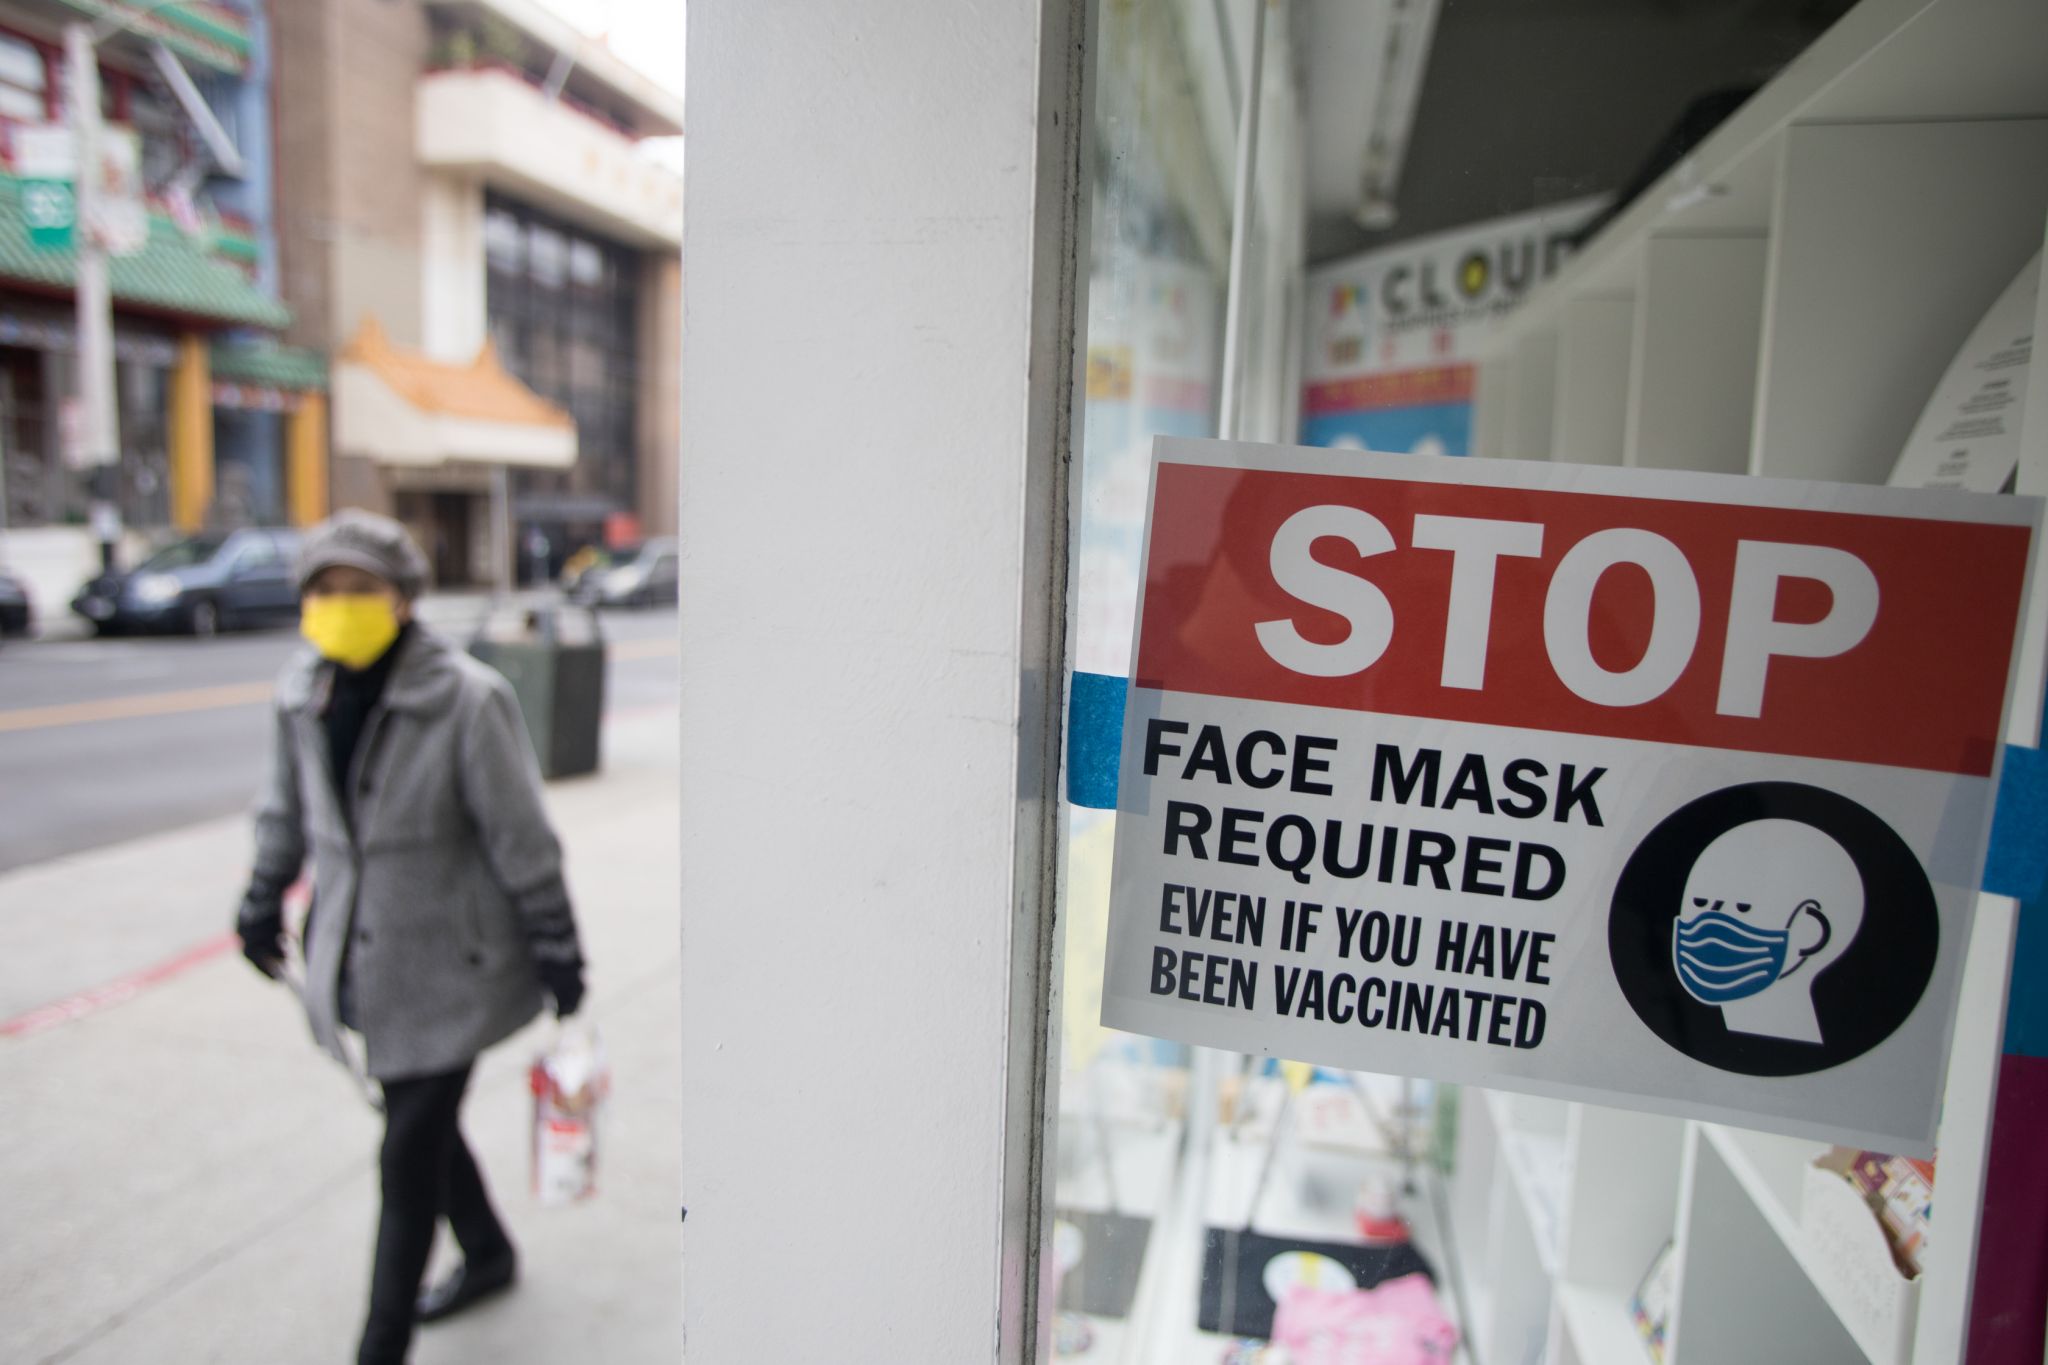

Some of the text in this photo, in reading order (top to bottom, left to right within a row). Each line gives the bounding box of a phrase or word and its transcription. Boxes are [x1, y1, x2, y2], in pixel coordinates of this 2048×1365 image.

[1254, 504, 1880, 719] STOP
[1143, 718, 1609, 828] FACE MASK
[1163, 800, 1567, 901] REQUIRED
[1159, 883, 1556, 986] EVEN IF YOU HAVE
[1150, 946, 1547, 1050] BEEN VACCINATED
